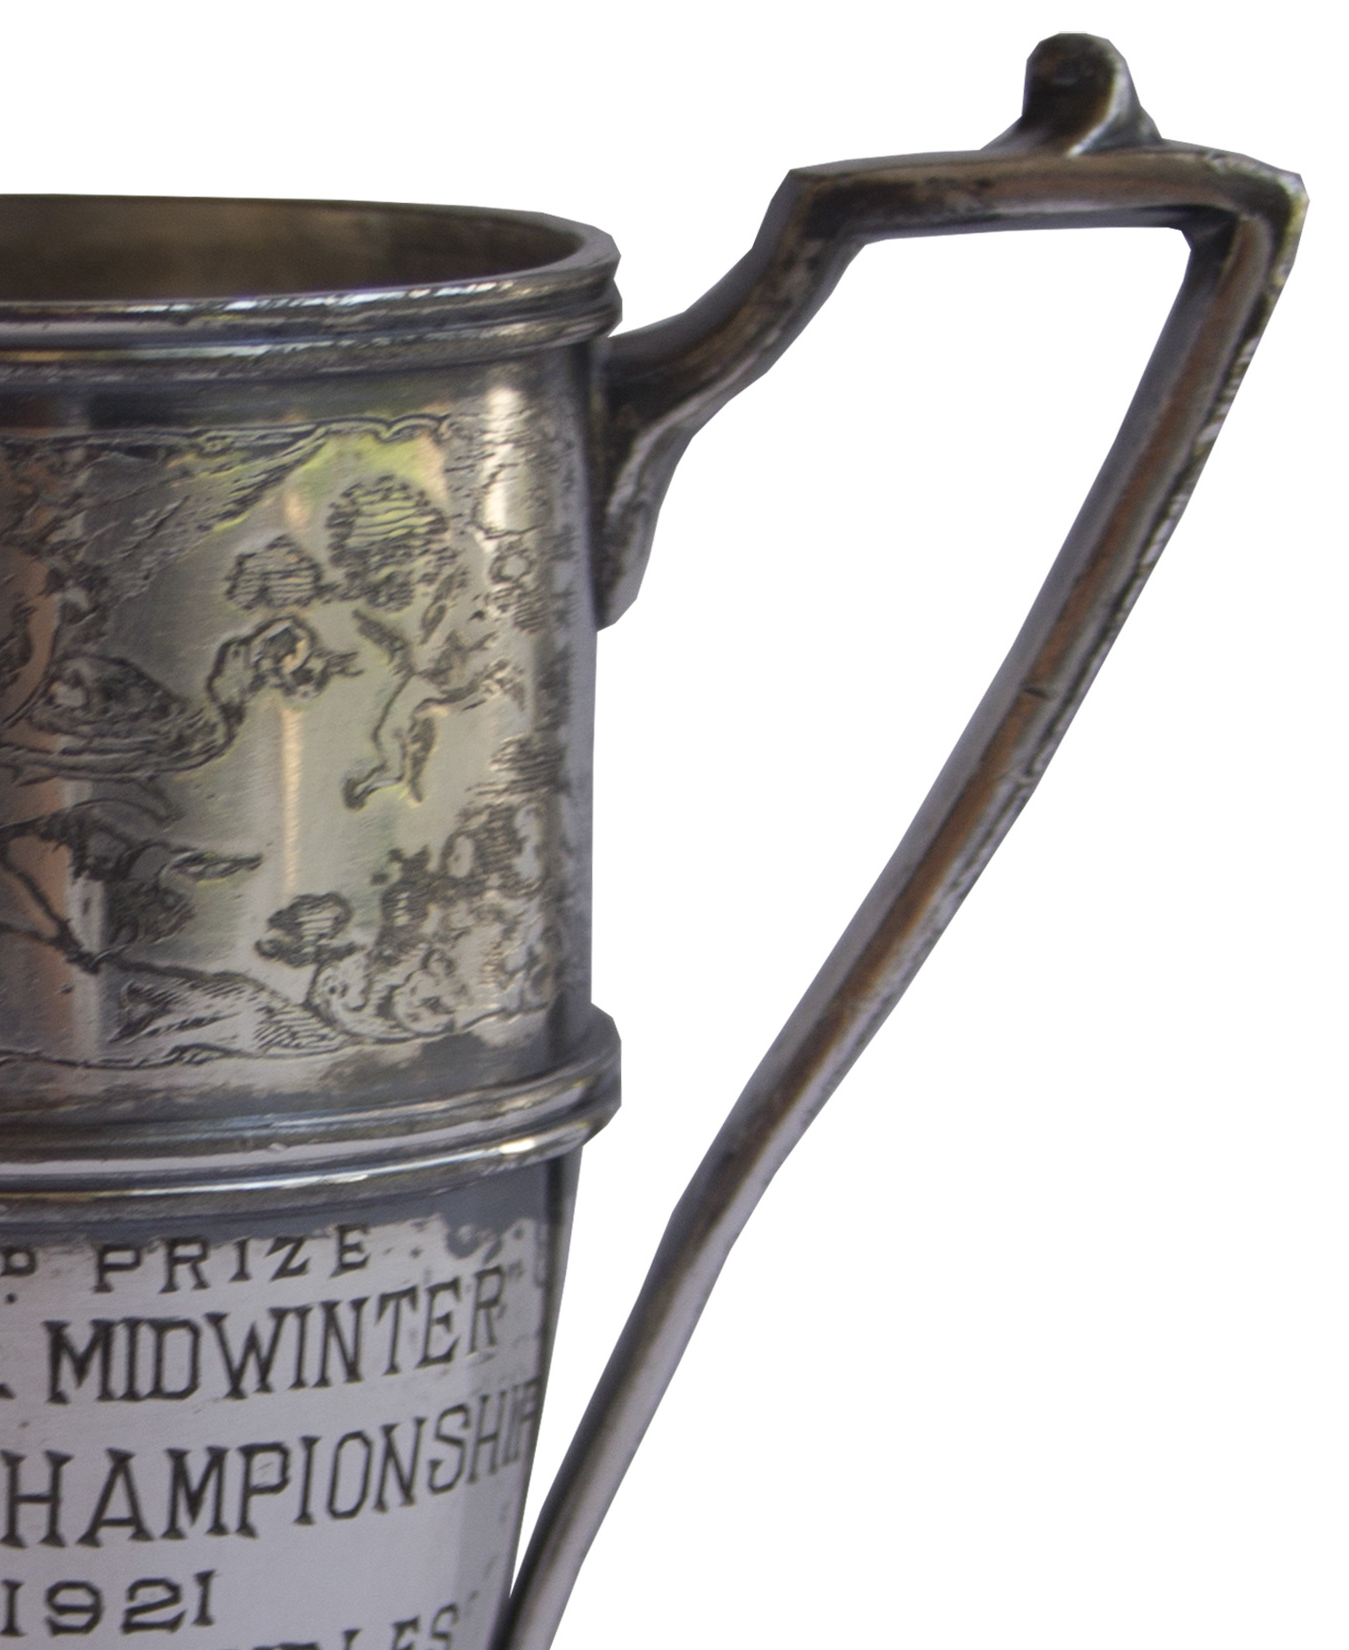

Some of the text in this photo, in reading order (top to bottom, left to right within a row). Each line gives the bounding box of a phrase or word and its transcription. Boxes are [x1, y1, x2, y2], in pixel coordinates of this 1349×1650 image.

[92, 1224, 370, 1293] PRIZE
[43, 1265, 507, 1404] MIDWINTER
[0, 1569, 216, 1637] 1921
